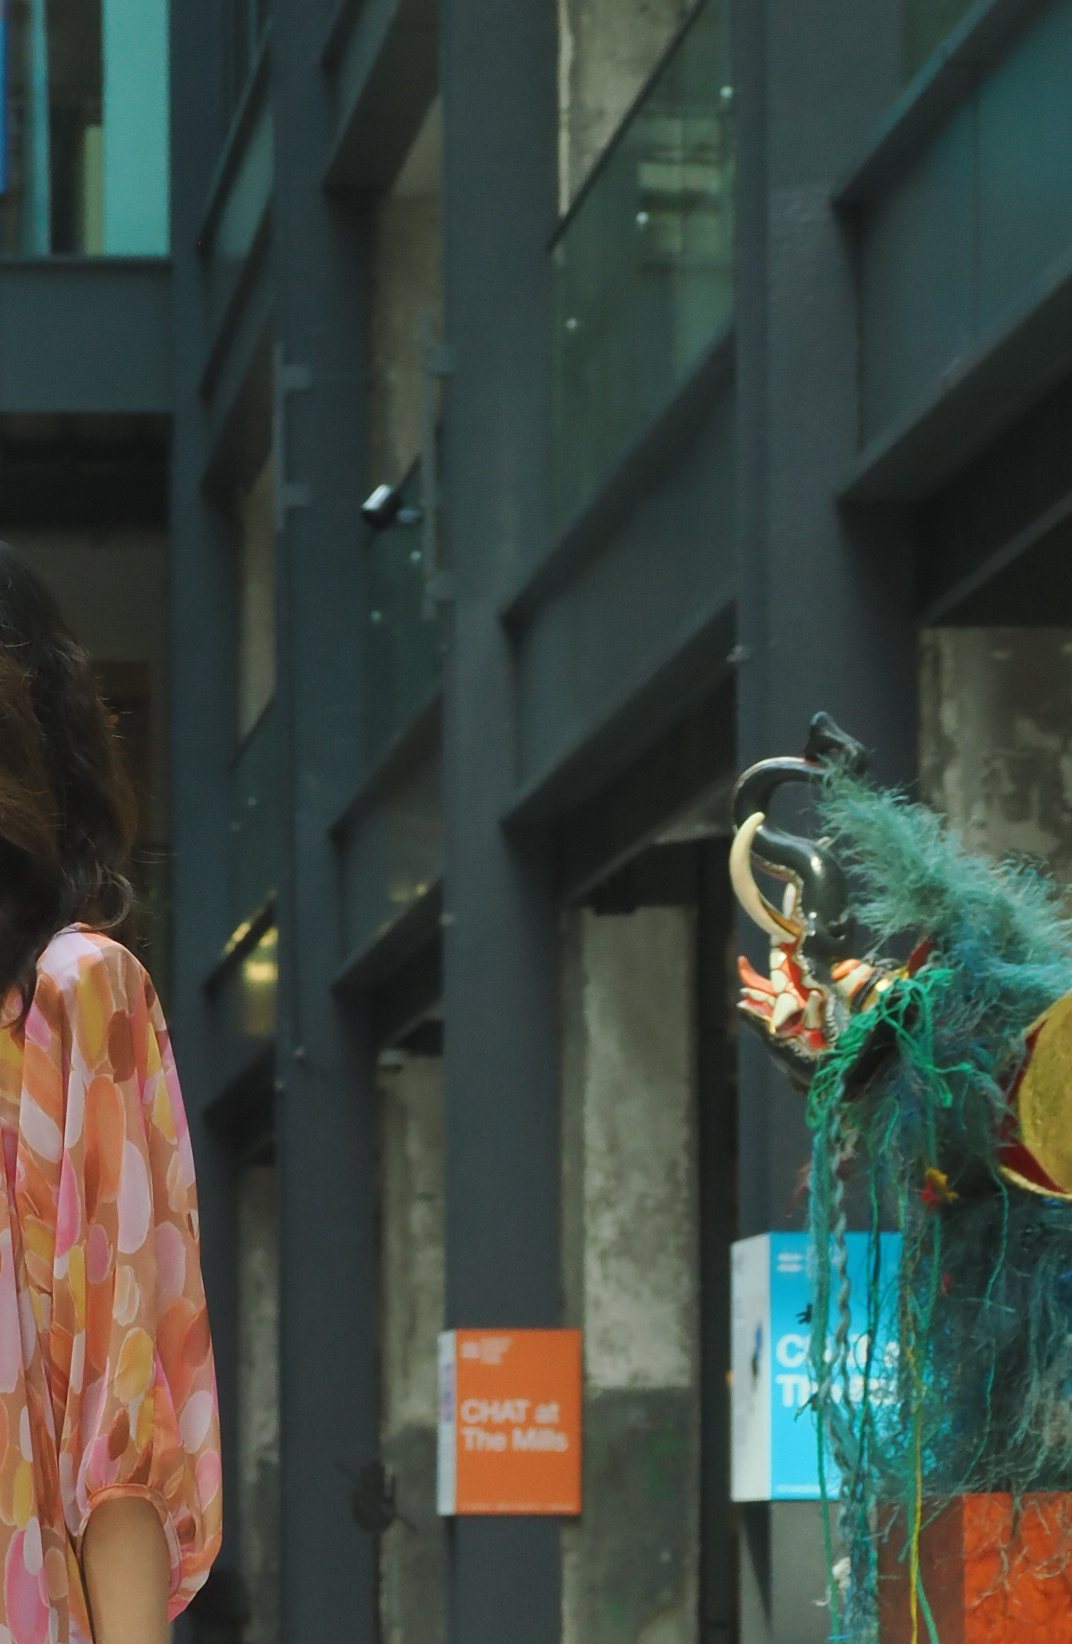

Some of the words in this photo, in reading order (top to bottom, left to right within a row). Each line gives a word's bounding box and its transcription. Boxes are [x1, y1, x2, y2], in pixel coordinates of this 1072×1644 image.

[461, 1399, 530, 1424] CHAT
[534, 1402, 559, 1424] at
[462, 1426, 507, 1452] The
[511, 1426, 568, 1452] Mills
